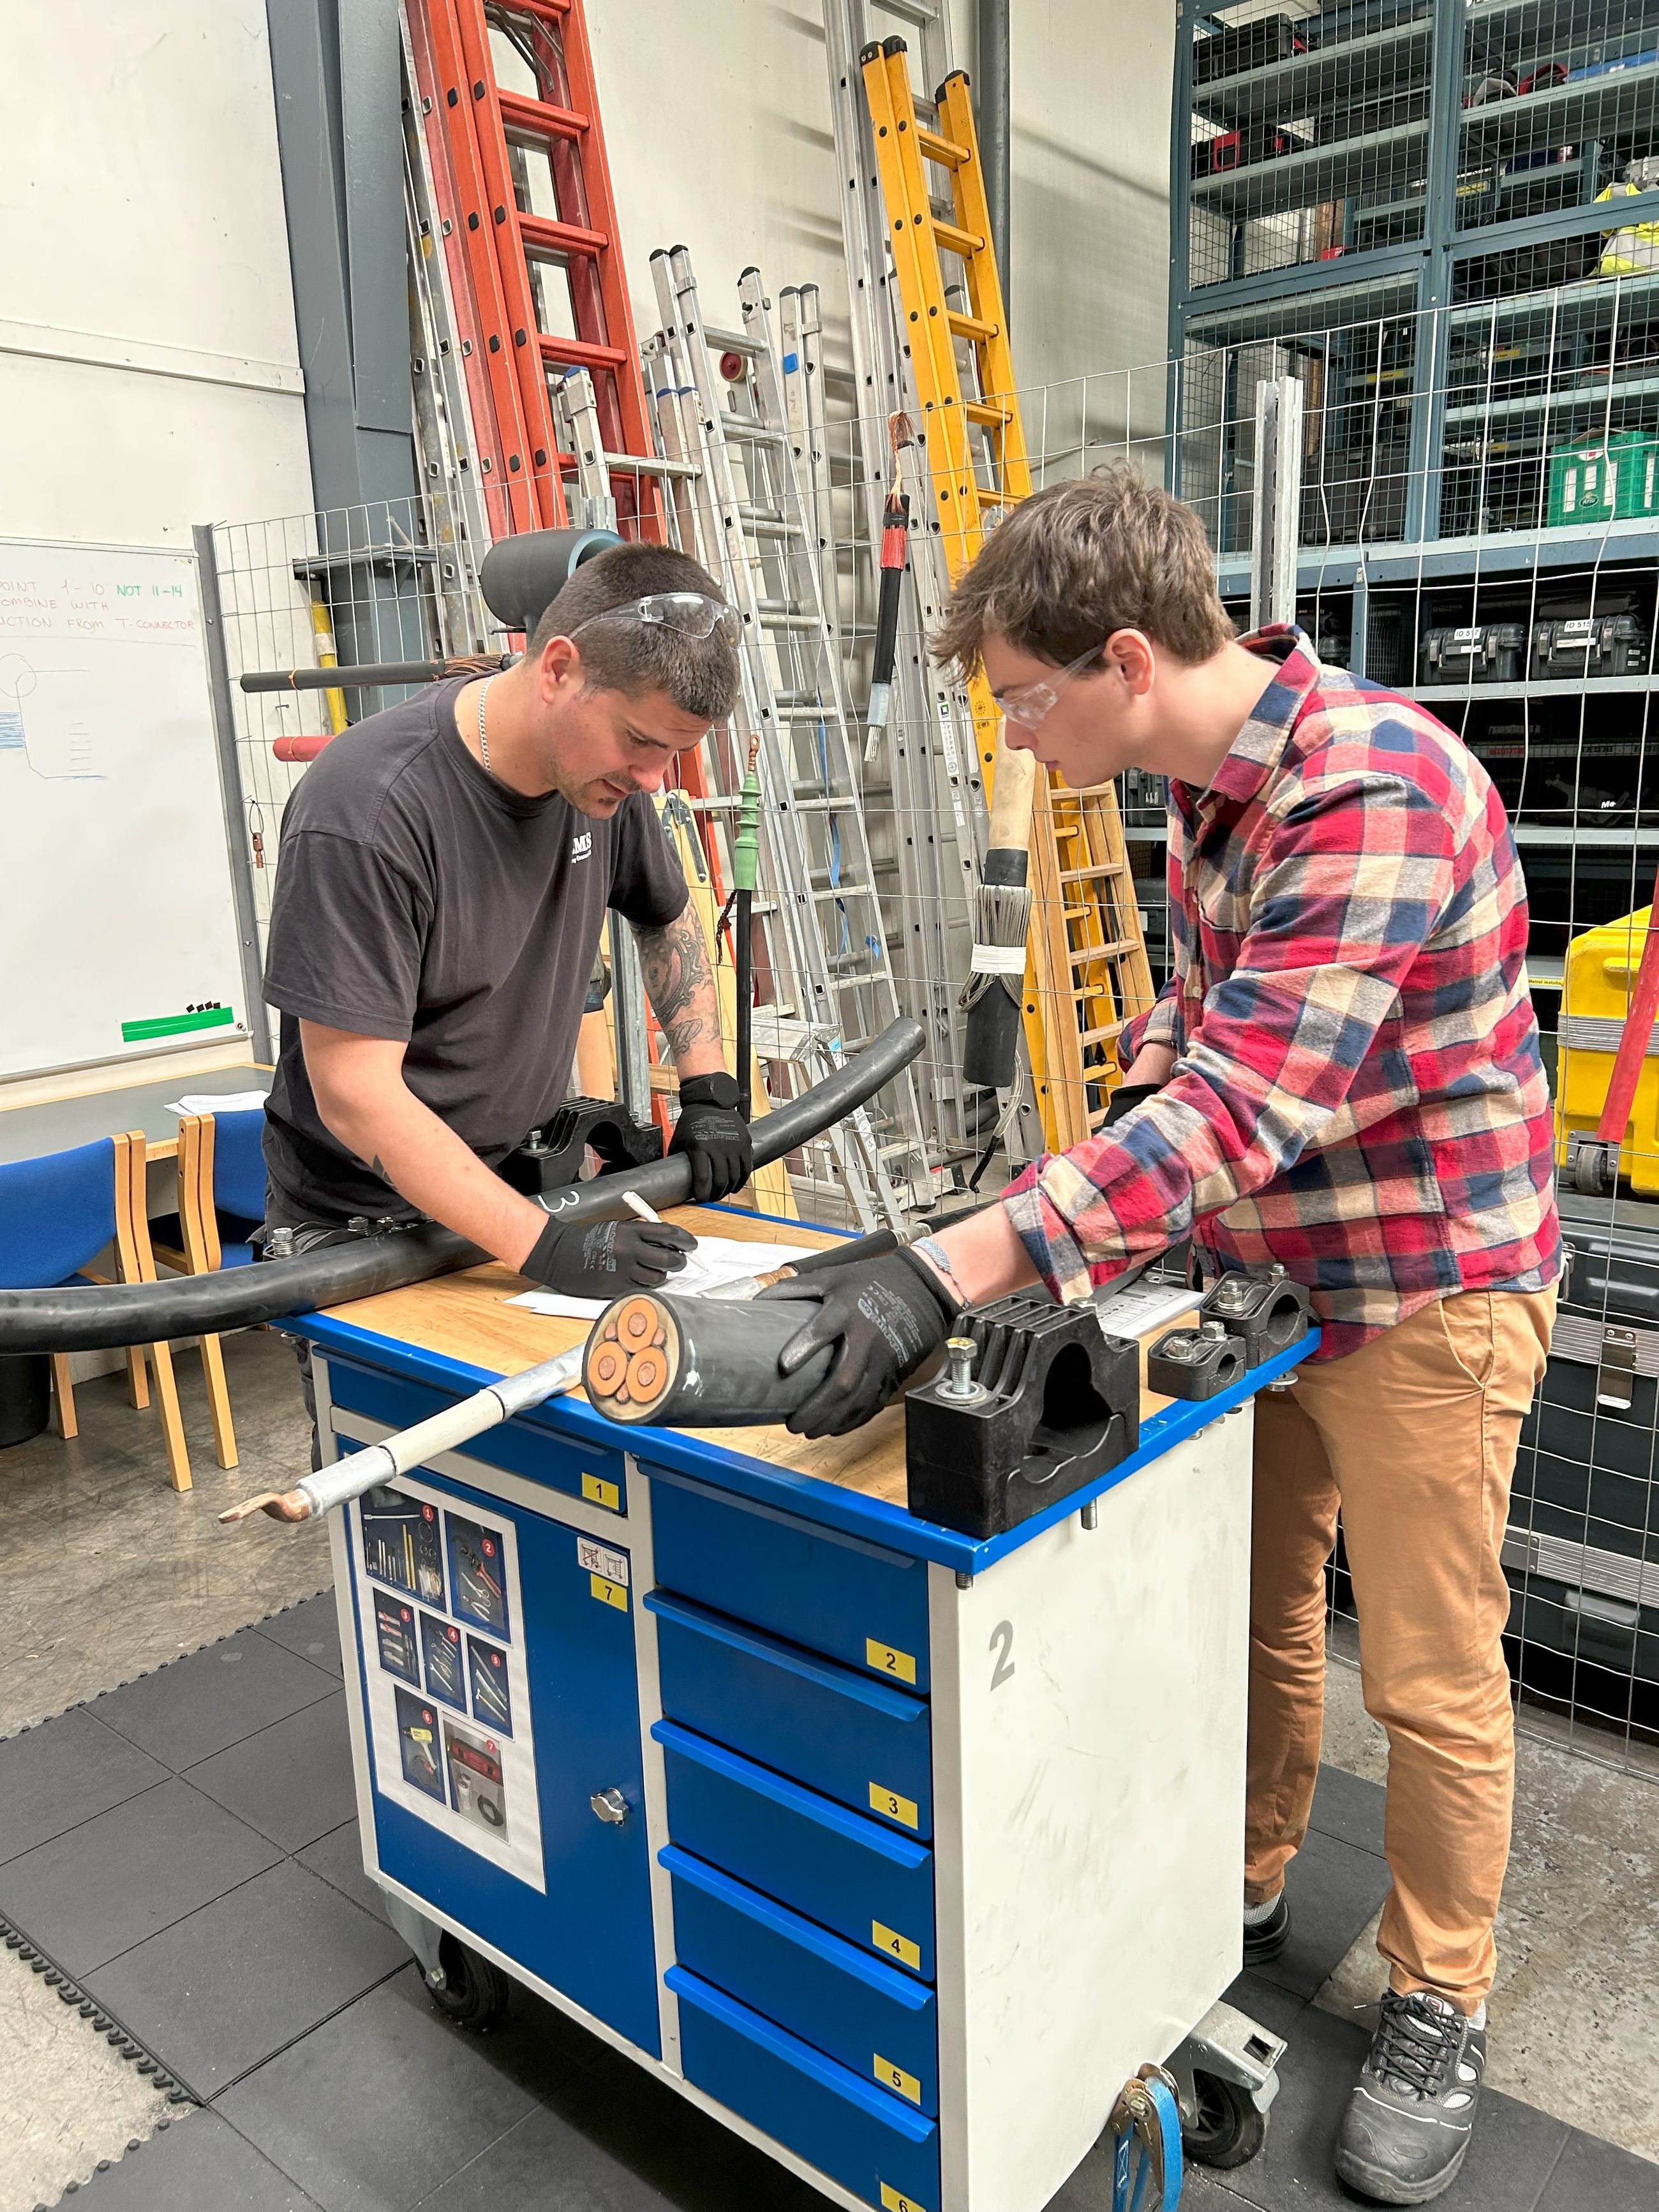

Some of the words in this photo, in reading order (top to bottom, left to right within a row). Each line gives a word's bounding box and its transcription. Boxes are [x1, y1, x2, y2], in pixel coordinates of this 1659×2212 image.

[117, 584, 141, 597] NOT
[0, 597, 57, 609] OMBINE
[71, 602, 108, 610] WITH
[67, 618, 104, 630] FROM
[115, 618, 195, 630] T-CONNECTOR
[572, 831, 592, 855] MS
[596, 1483, 602, 1499] 1
[426, 1508, 431, 1518] 1
[486, 1543, 491, 1554] 2
[605, 1585, 613, 1601] 7
[450, 1629, 456, 1639] 4
[493, 1656, 498, 1665] 5
[886, 1652, 896, 1671] 2
[989, 1620, 1015, 1693] 2
[888, 1797, 898, 1815] 3
[891, 1938, 900, 1954] 4
[892, 2070, 902, 2087] 5
